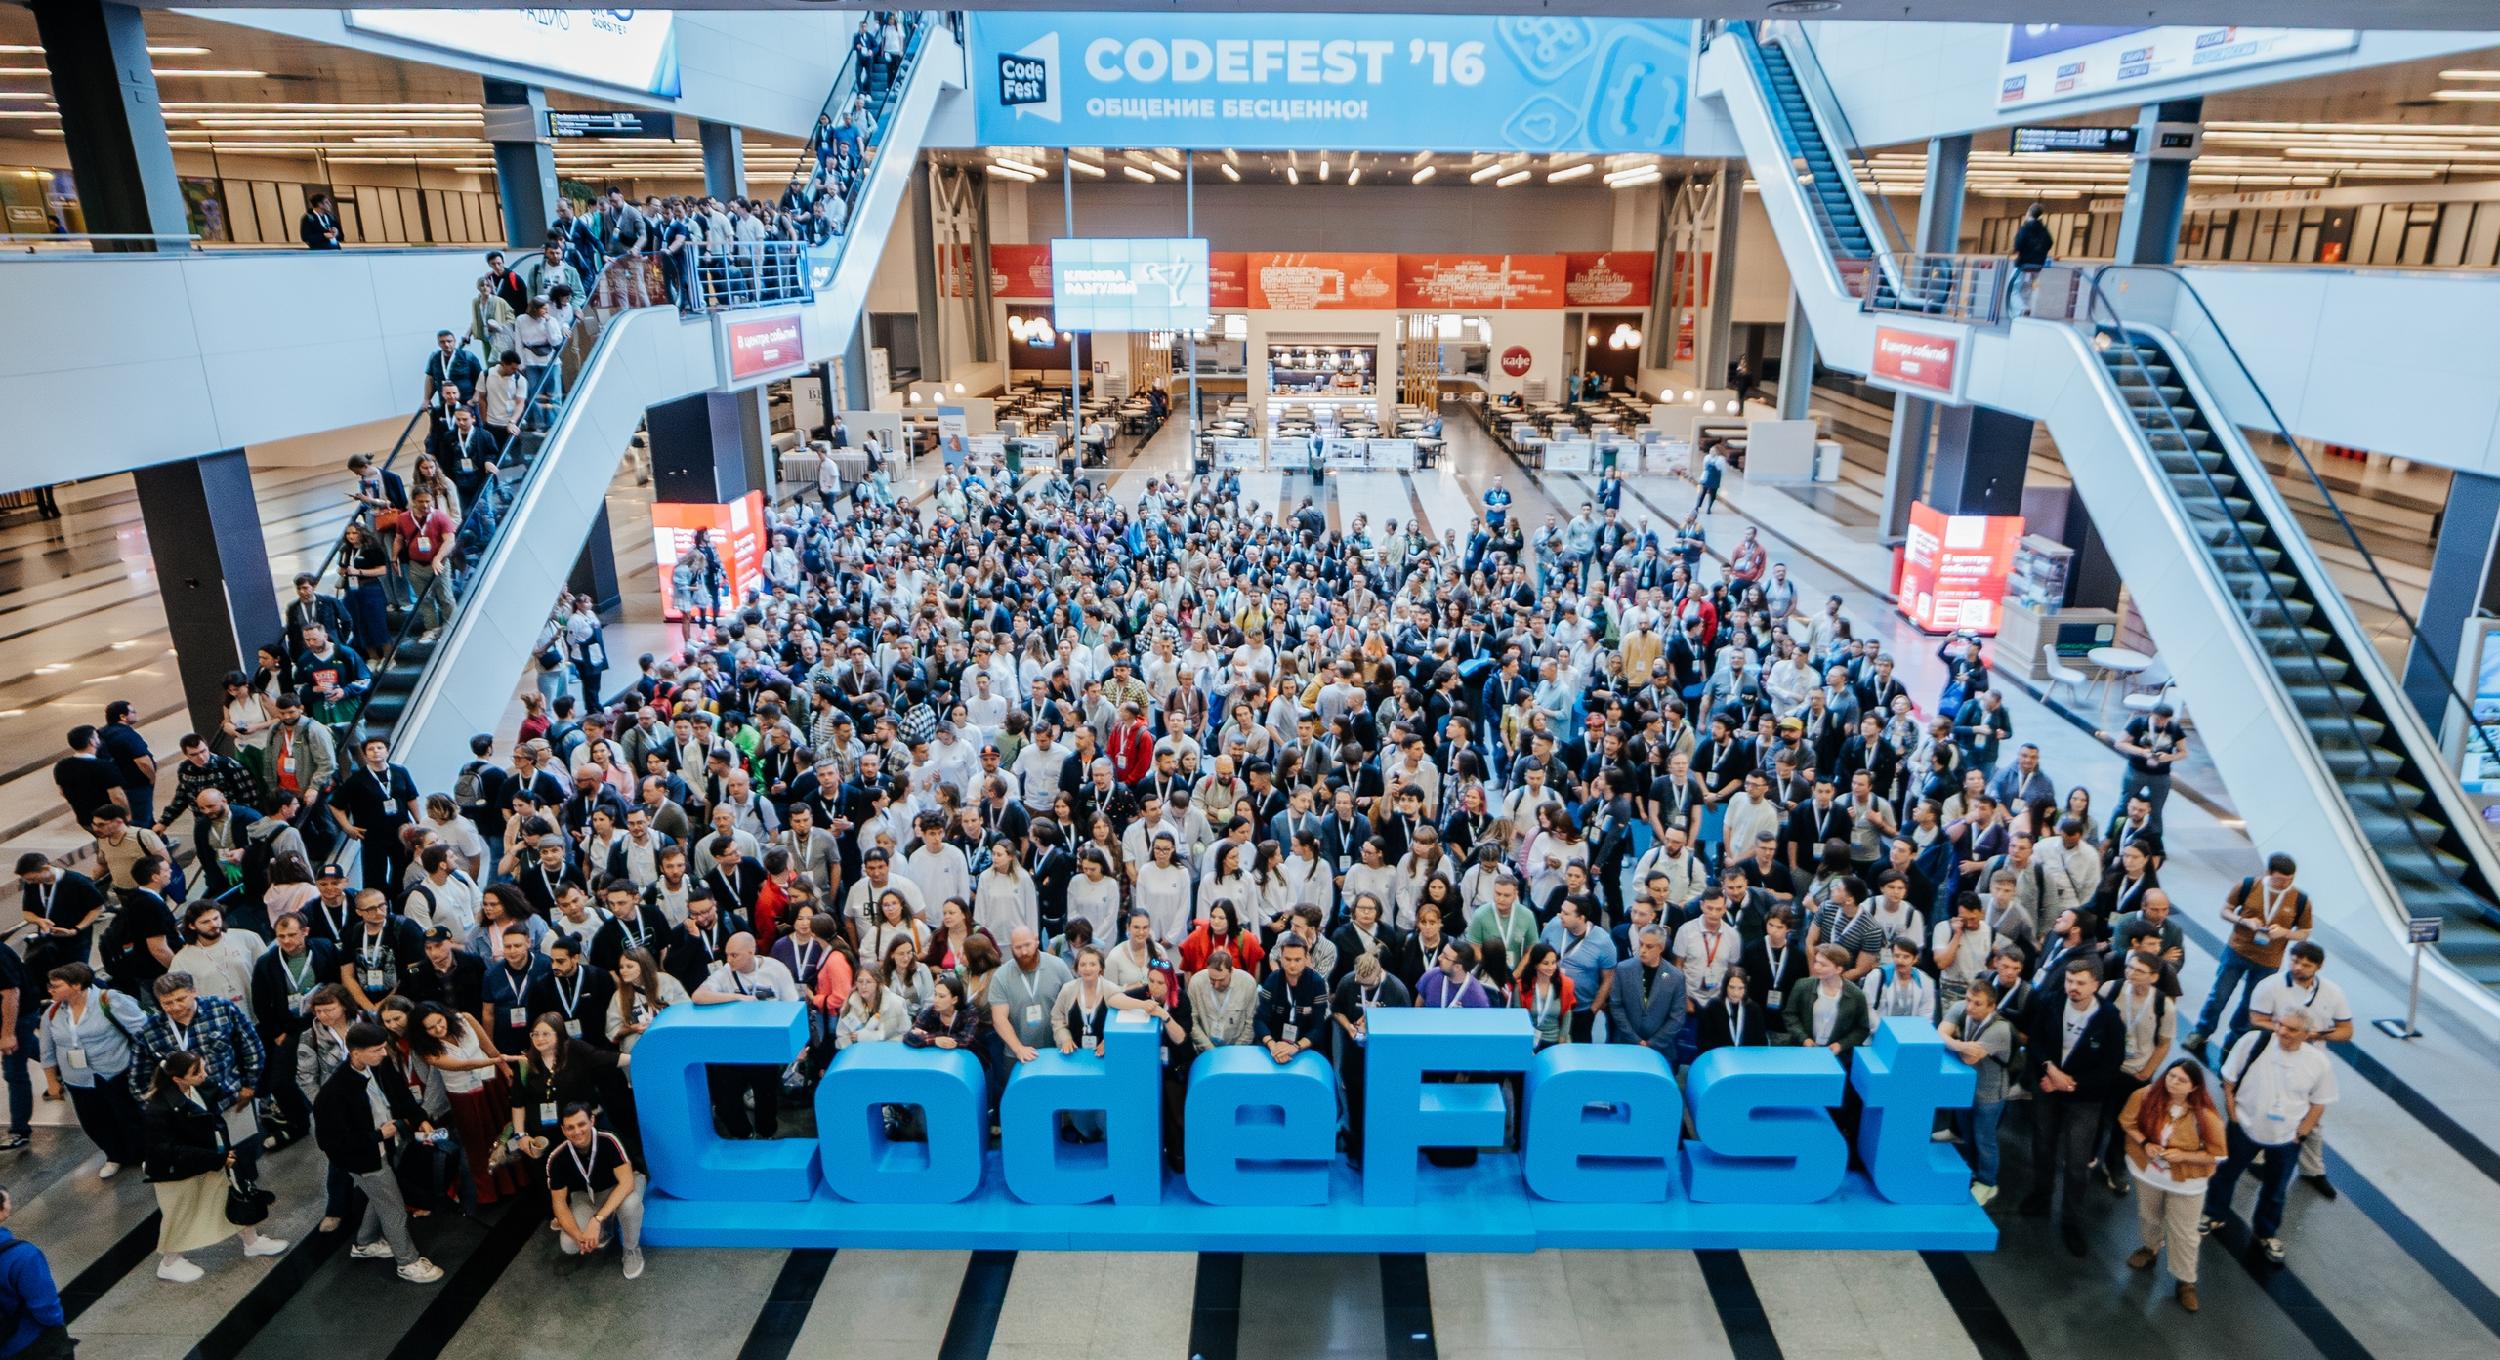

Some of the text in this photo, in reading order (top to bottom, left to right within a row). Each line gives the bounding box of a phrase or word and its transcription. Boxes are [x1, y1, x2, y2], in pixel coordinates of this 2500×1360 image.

[1002, 59, 1044, 81] Code
[1085, 37, 1394, 84] CODEFEST
[1003, 79, 1041, 100] Fest
[1086, 97, 1369, 121] ОБЩЕНИЕ БЕСЦЕННО!
[744, 333, 770, 349] центре
[770, 325, 797, 343] событий
[1503, 353, 1531, 369] кафе
[630, 1000, 1978, 1207] CodeFest
